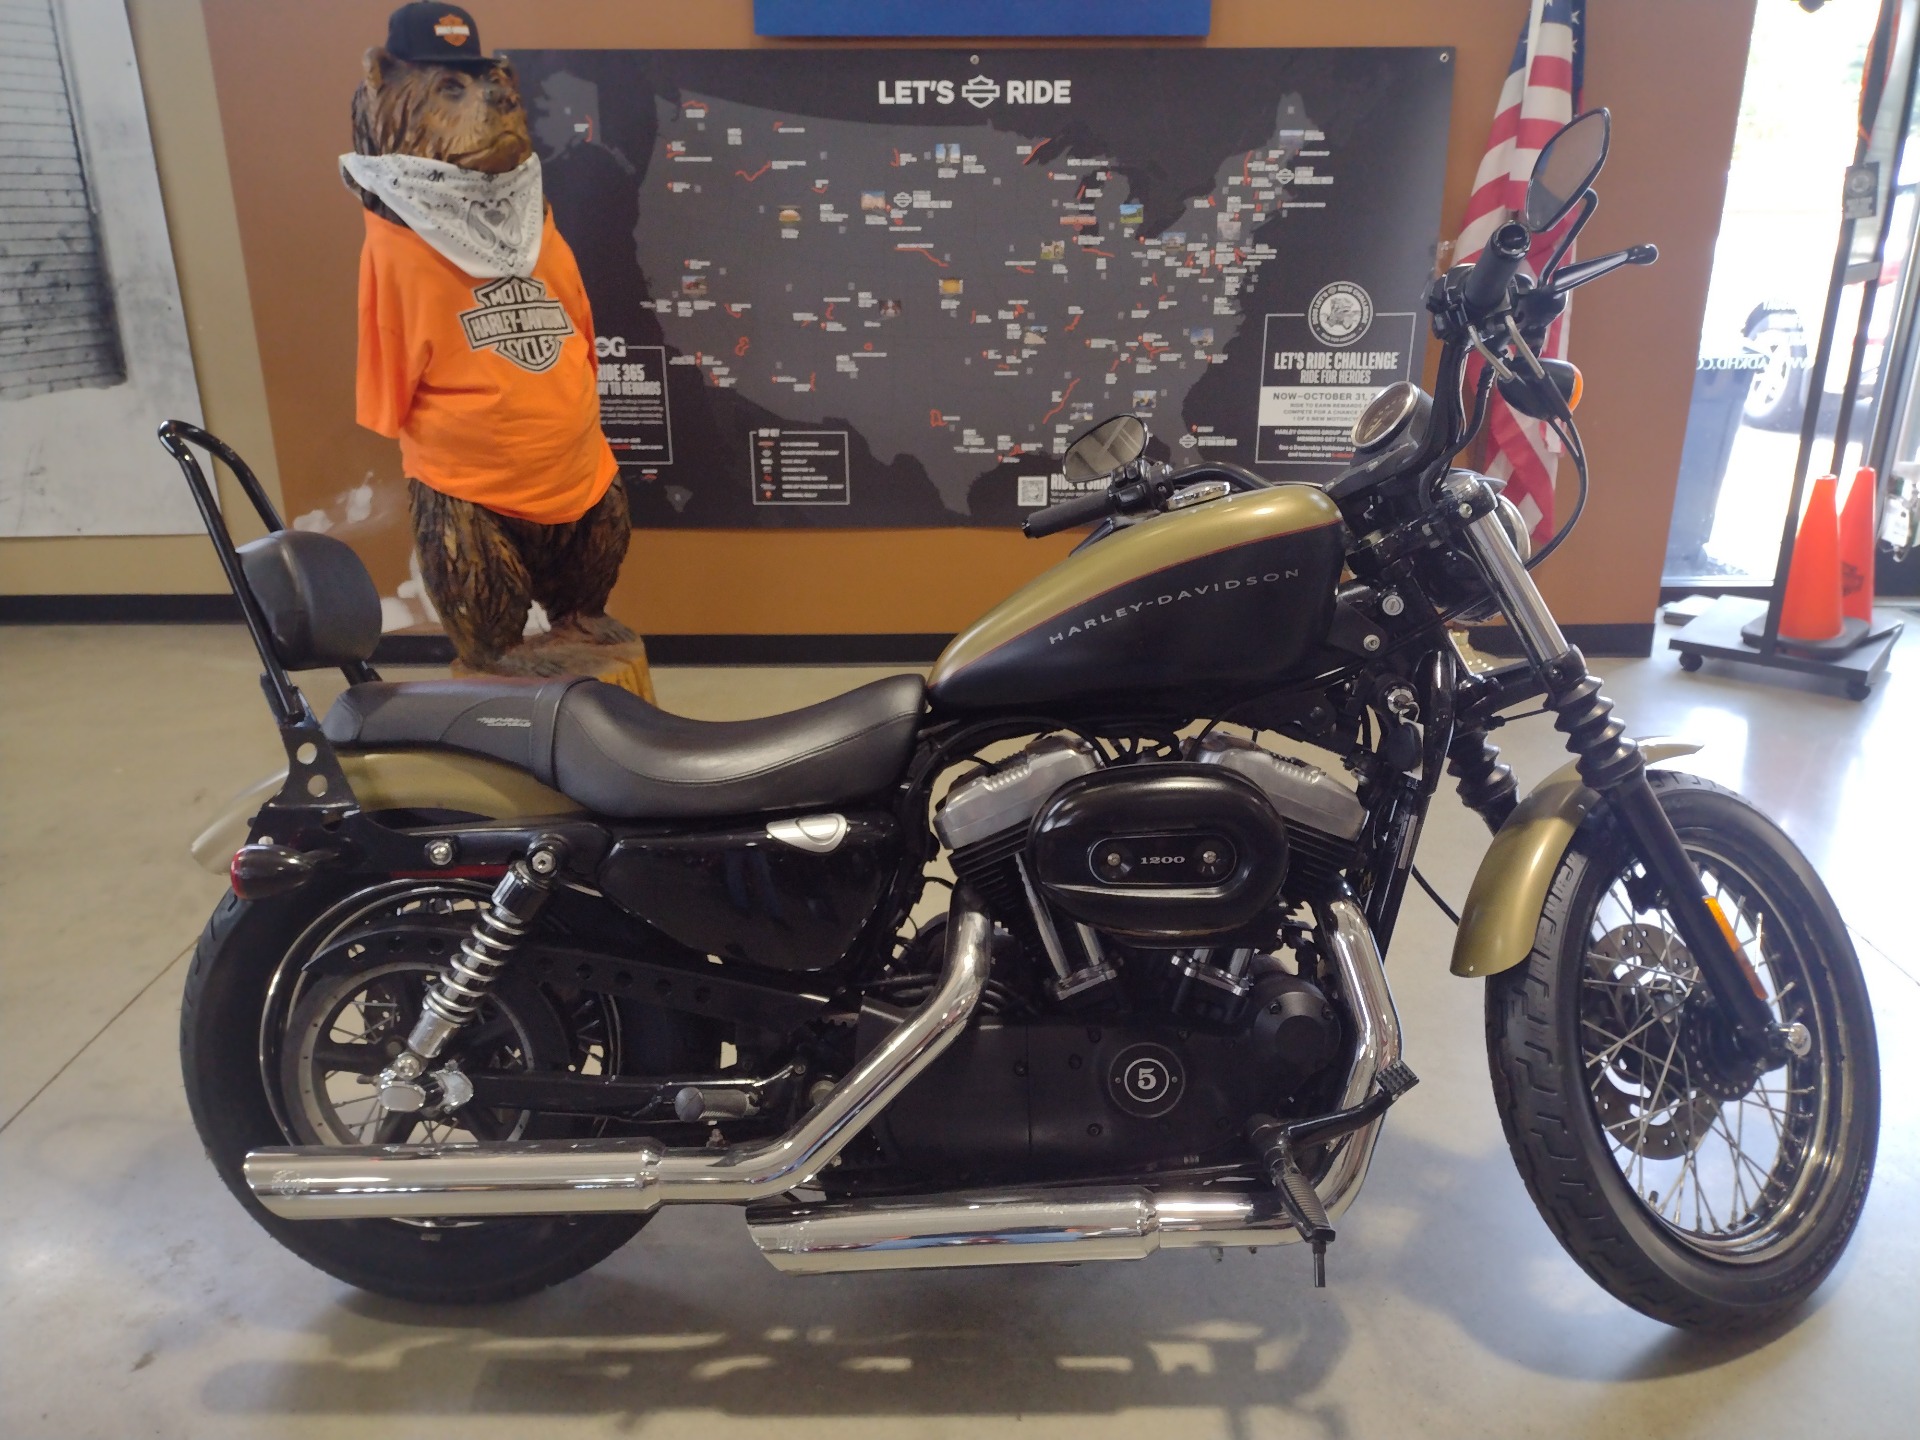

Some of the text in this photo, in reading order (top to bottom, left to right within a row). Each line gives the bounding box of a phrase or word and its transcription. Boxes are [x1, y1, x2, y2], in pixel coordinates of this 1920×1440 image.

[878, 80, 1072, 104] LET'S RIDE
[469, 307, 567, 340] HARLEY-DAV
[505, 335, 556, 364] CYCLES
[594, 336, 627, 358] OG
[1274, 352, 1399, 370] LET'S RIDE CHALLENGE
[622, 364, 646, 381] 365
[1300, 370, 1372, 384] RIDE FOR HEROES
[1049, 568, 1299, 645] HARLEY-DAVIDSON
[1140, 856, 1185, 865] 1200
[1137, 1067, 1157, 1090] 5
